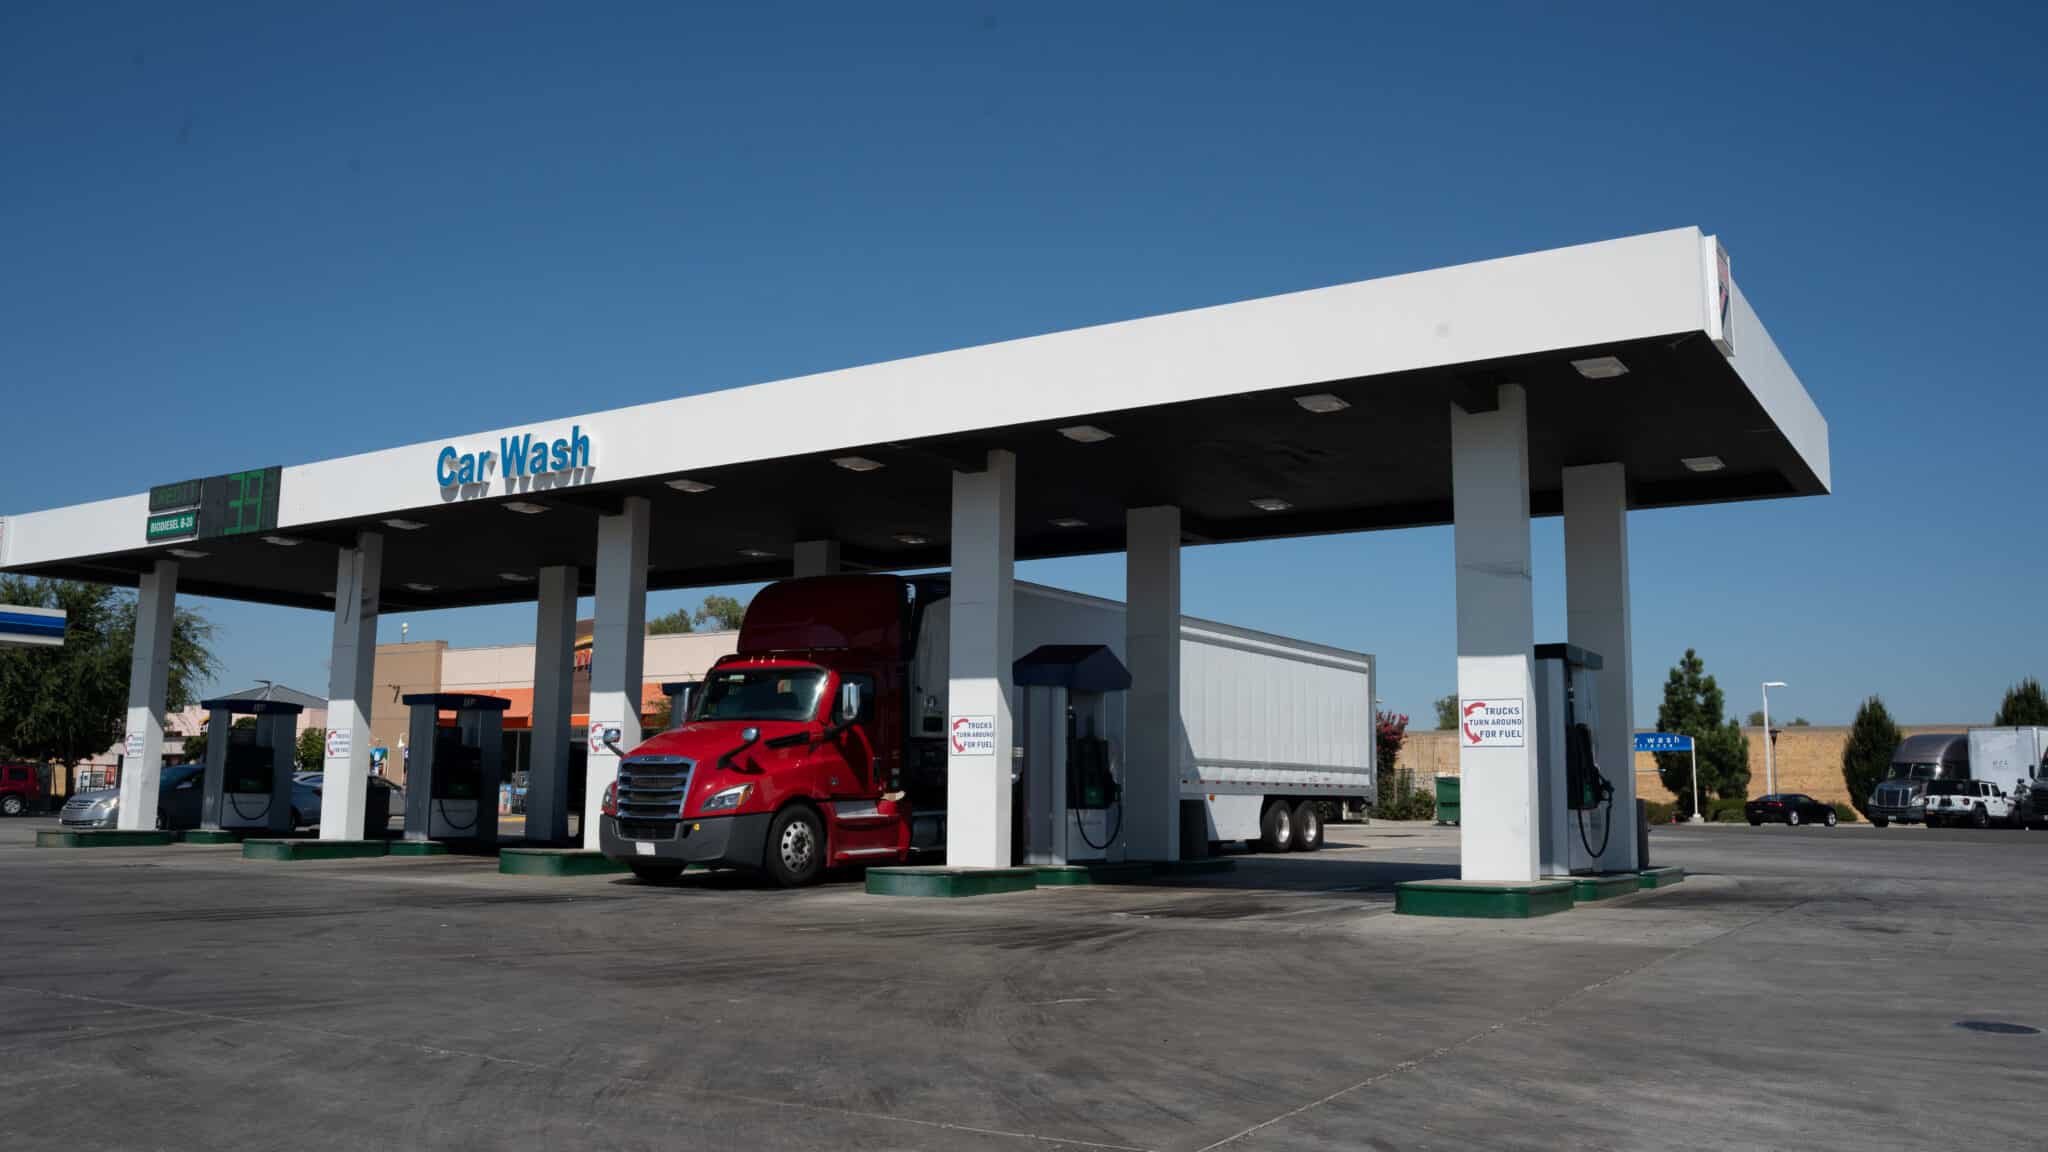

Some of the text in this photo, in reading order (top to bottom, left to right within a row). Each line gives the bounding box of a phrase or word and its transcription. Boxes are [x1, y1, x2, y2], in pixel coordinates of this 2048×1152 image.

[437, 425, 590, 487] Car Wash
[150, 519, 179, 533] BIODIESEL
[1485, 706, 1520, 715] TRUCKS
[1491, 718, 1522, 726] AROUND
[1480, 729, 1522, 738] FOR FUEL
